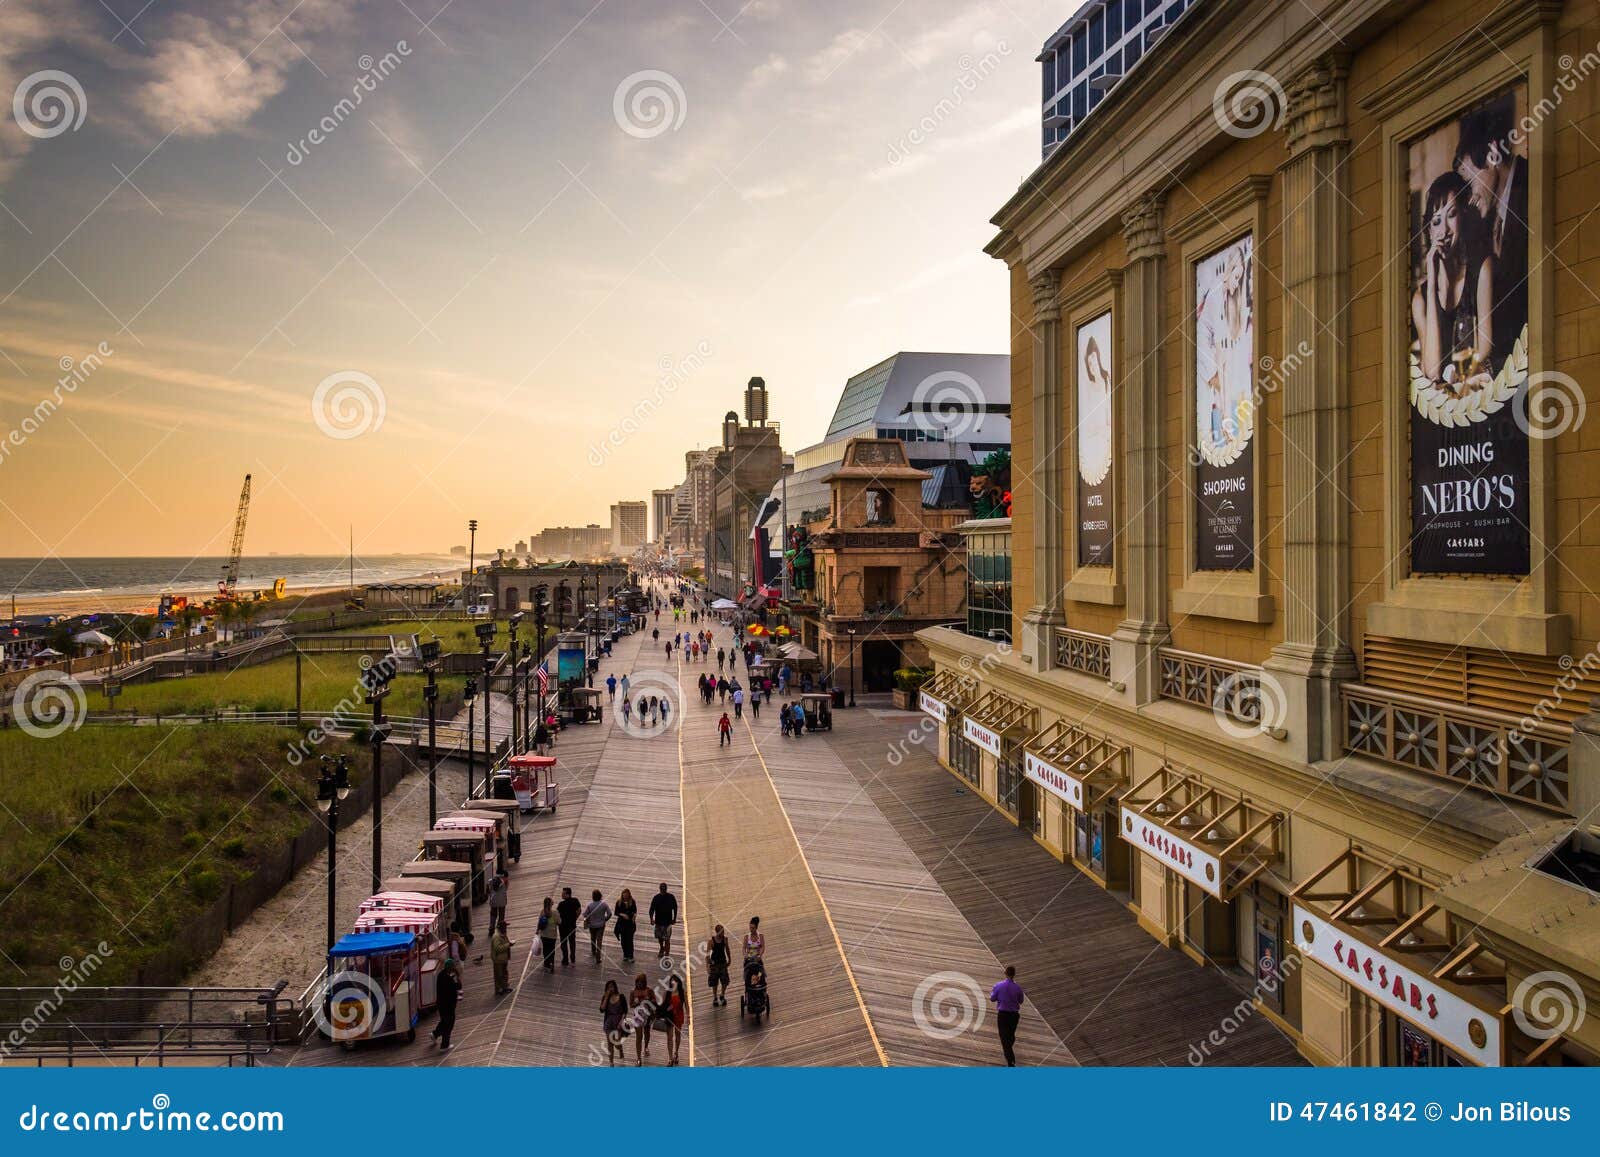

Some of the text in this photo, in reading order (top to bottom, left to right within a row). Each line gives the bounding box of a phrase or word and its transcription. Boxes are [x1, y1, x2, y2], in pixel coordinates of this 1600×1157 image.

[1438, 441, 1494, 468] DINING
[1203, 476, 1246, 496] SHOPPING
[1421, 474, 1515, 515] NERO'S
[1087, 494, 1103, 507] HOTEL
[1425, 517, 1510, 530] CHOPHOUSE SUSHI BAR
[1447, 537, 1485, 548] CAESARS
[971, 725, 992, 746] CAESARS
[1037, 764, 1068, 793] CAESARS
[1142, 826, 1193, 869] CAESARS
[1333, 939, 1439, 1020] CAESARS
